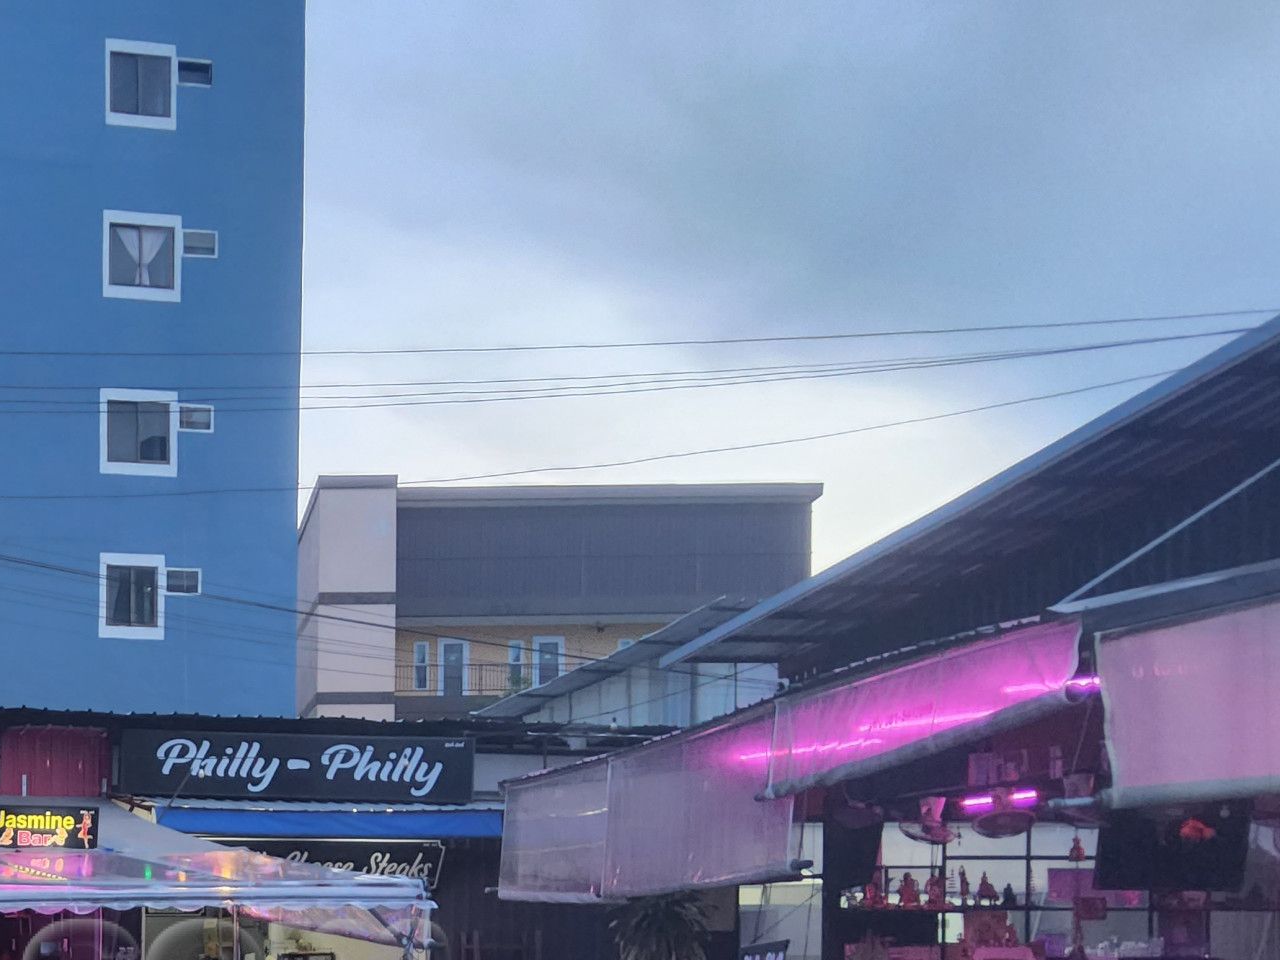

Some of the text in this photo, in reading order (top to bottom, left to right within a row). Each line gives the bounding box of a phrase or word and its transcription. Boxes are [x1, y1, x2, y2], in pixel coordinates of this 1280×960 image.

[156, 738, 280, 792] Philly
[321, 744, 443, 797] Philly
[17, 831, 51, 847] Bar
[363, 852, 432, 878] Steaks
